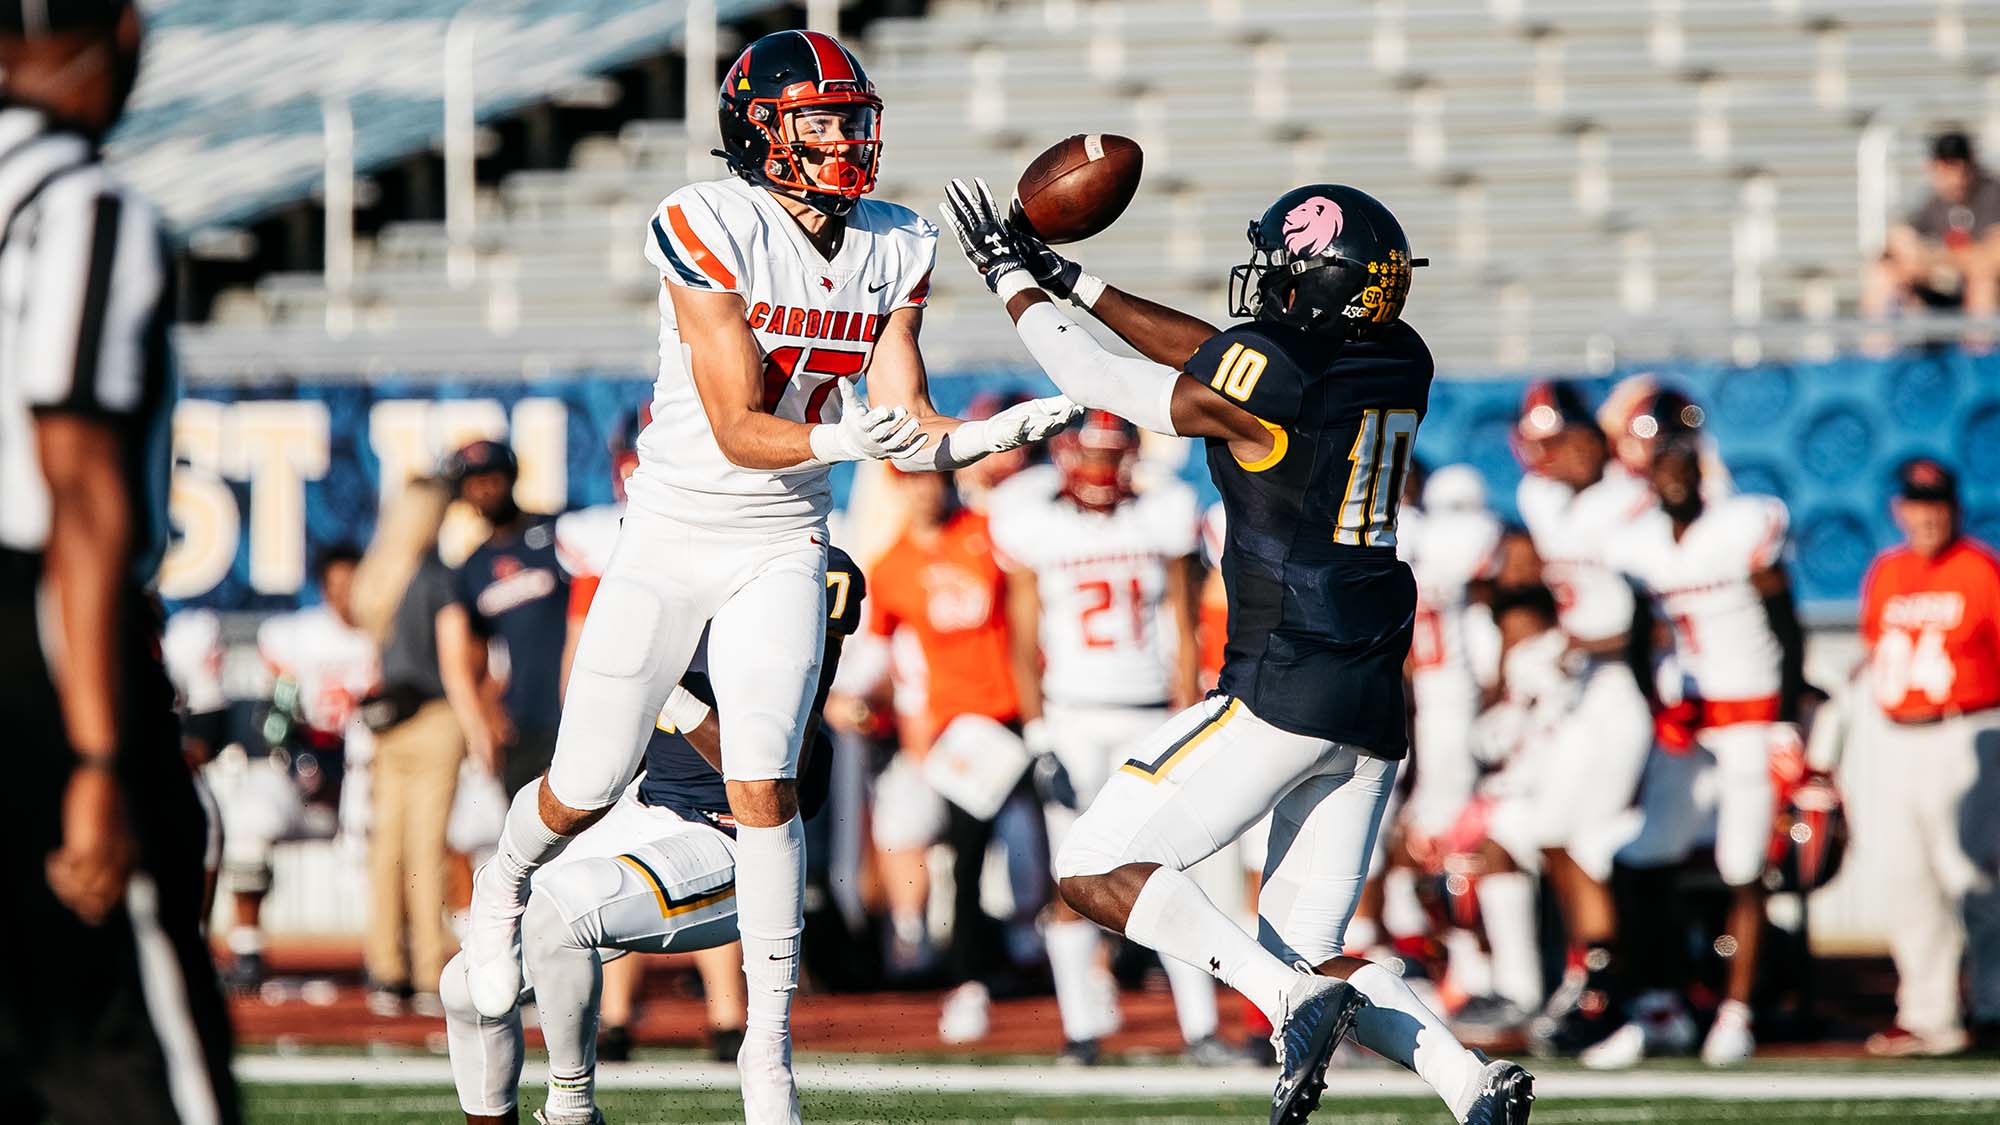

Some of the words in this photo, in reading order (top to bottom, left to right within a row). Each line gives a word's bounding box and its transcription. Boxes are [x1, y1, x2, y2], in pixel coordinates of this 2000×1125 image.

[749, 302, 881, 342] CARDINAL
[1364, 290, 1382, 305] SR
[762, 346, 866, 424] 17
[1210, 342, 1268, 402] 10
[1333, 408, 1418, 547] 10
[1075, 578, 1146, 651] 21
